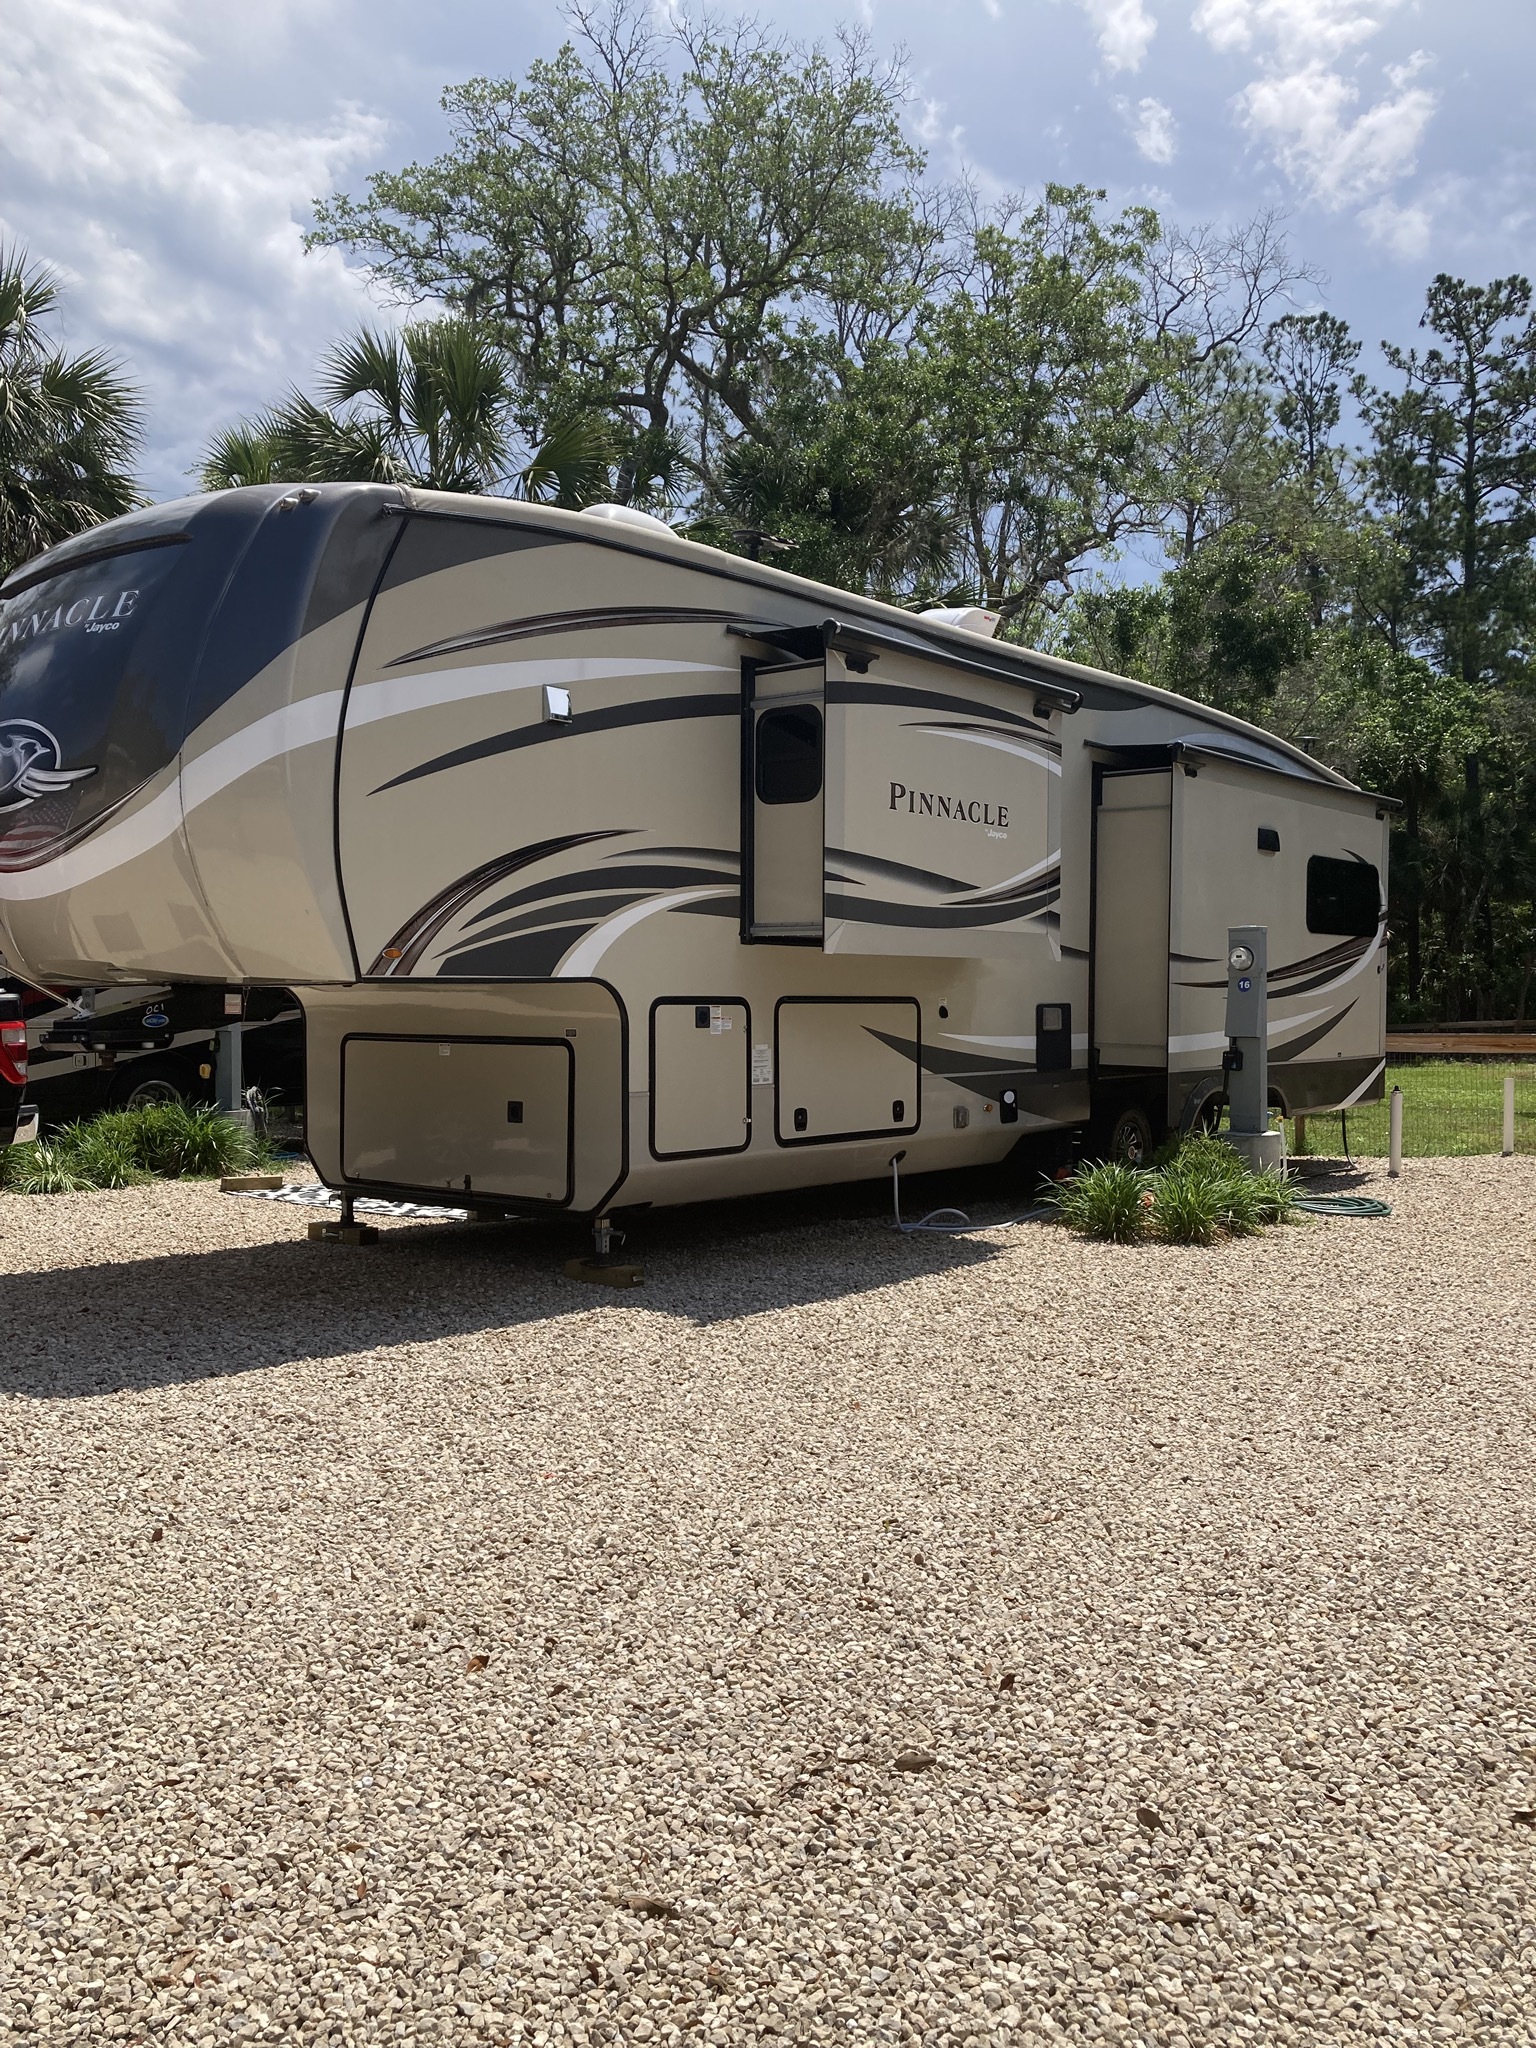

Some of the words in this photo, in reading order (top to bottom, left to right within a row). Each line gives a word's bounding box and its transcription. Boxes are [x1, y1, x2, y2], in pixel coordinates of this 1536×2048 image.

[0, 589, 140, 646] INNACLE
[86, 622, 120, 633] Jayco
[889, 781, 1009, 828] PINNACLE
[987, 829, 1008, 840] Jayco
[1239, 981, 1250, 989] 16
